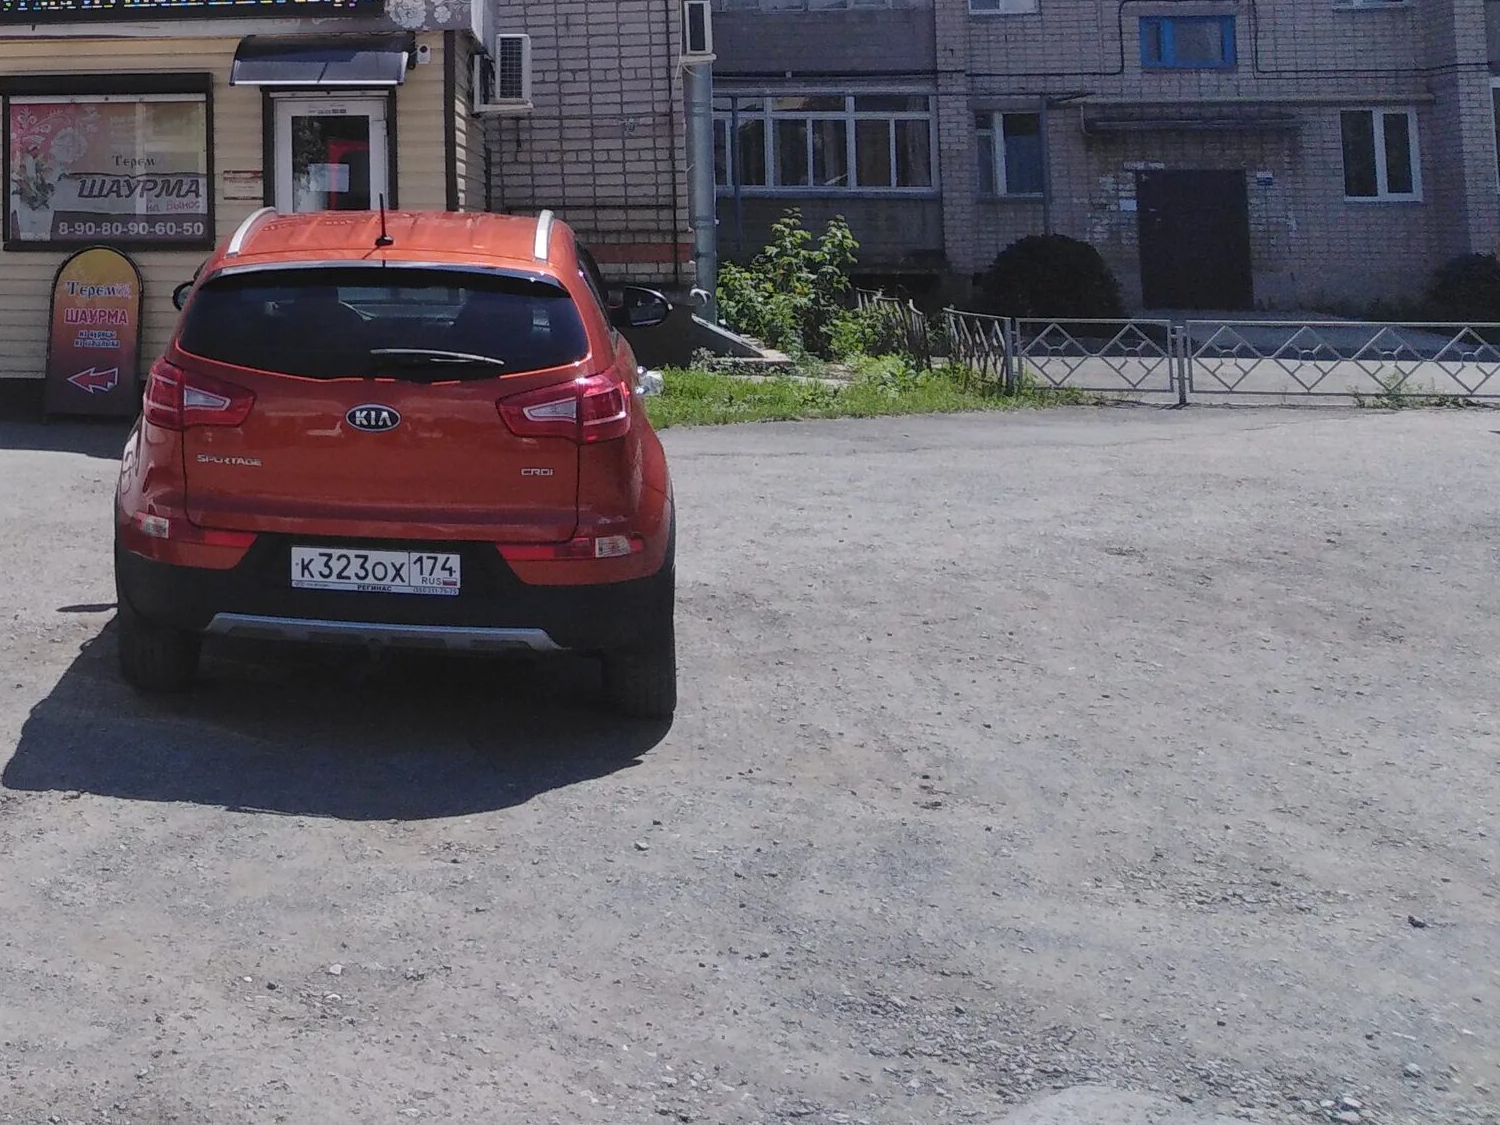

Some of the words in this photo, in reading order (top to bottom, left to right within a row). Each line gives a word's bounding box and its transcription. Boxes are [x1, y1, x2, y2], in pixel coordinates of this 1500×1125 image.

[77, 178, 202, 199] ШАУРМА
[58, 222, 204, 236] 8-90-80-90-60-50
[64, 308, 128, 324] ШАУРМА
[355, 410, 392, 426] KIA
[301, 552, 406, 583] К323ОХ
[412, 555, 453, 577] 174
[421, 577, 442, 586] RUS
